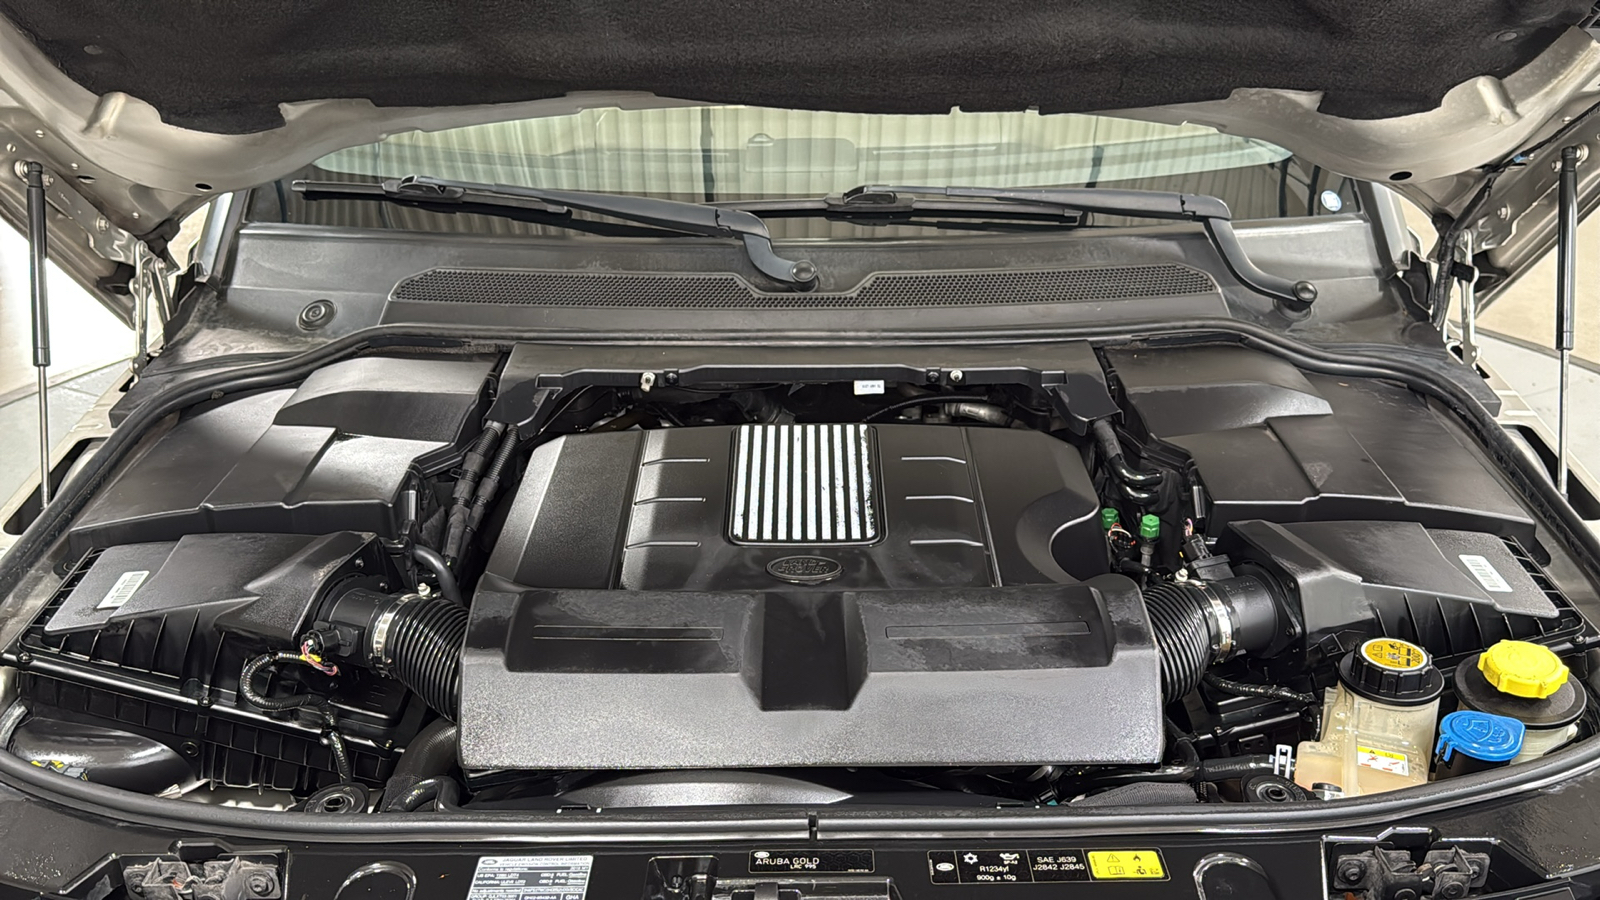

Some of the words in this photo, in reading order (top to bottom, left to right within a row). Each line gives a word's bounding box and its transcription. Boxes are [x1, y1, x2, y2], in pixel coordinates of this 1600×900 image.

[792, 857, 820, 865] GOLD
[1033, 863, 1058, 871] J2842
[976, 874, 995, 882] 900g
[1003, 874, 1017, 882] 10g
